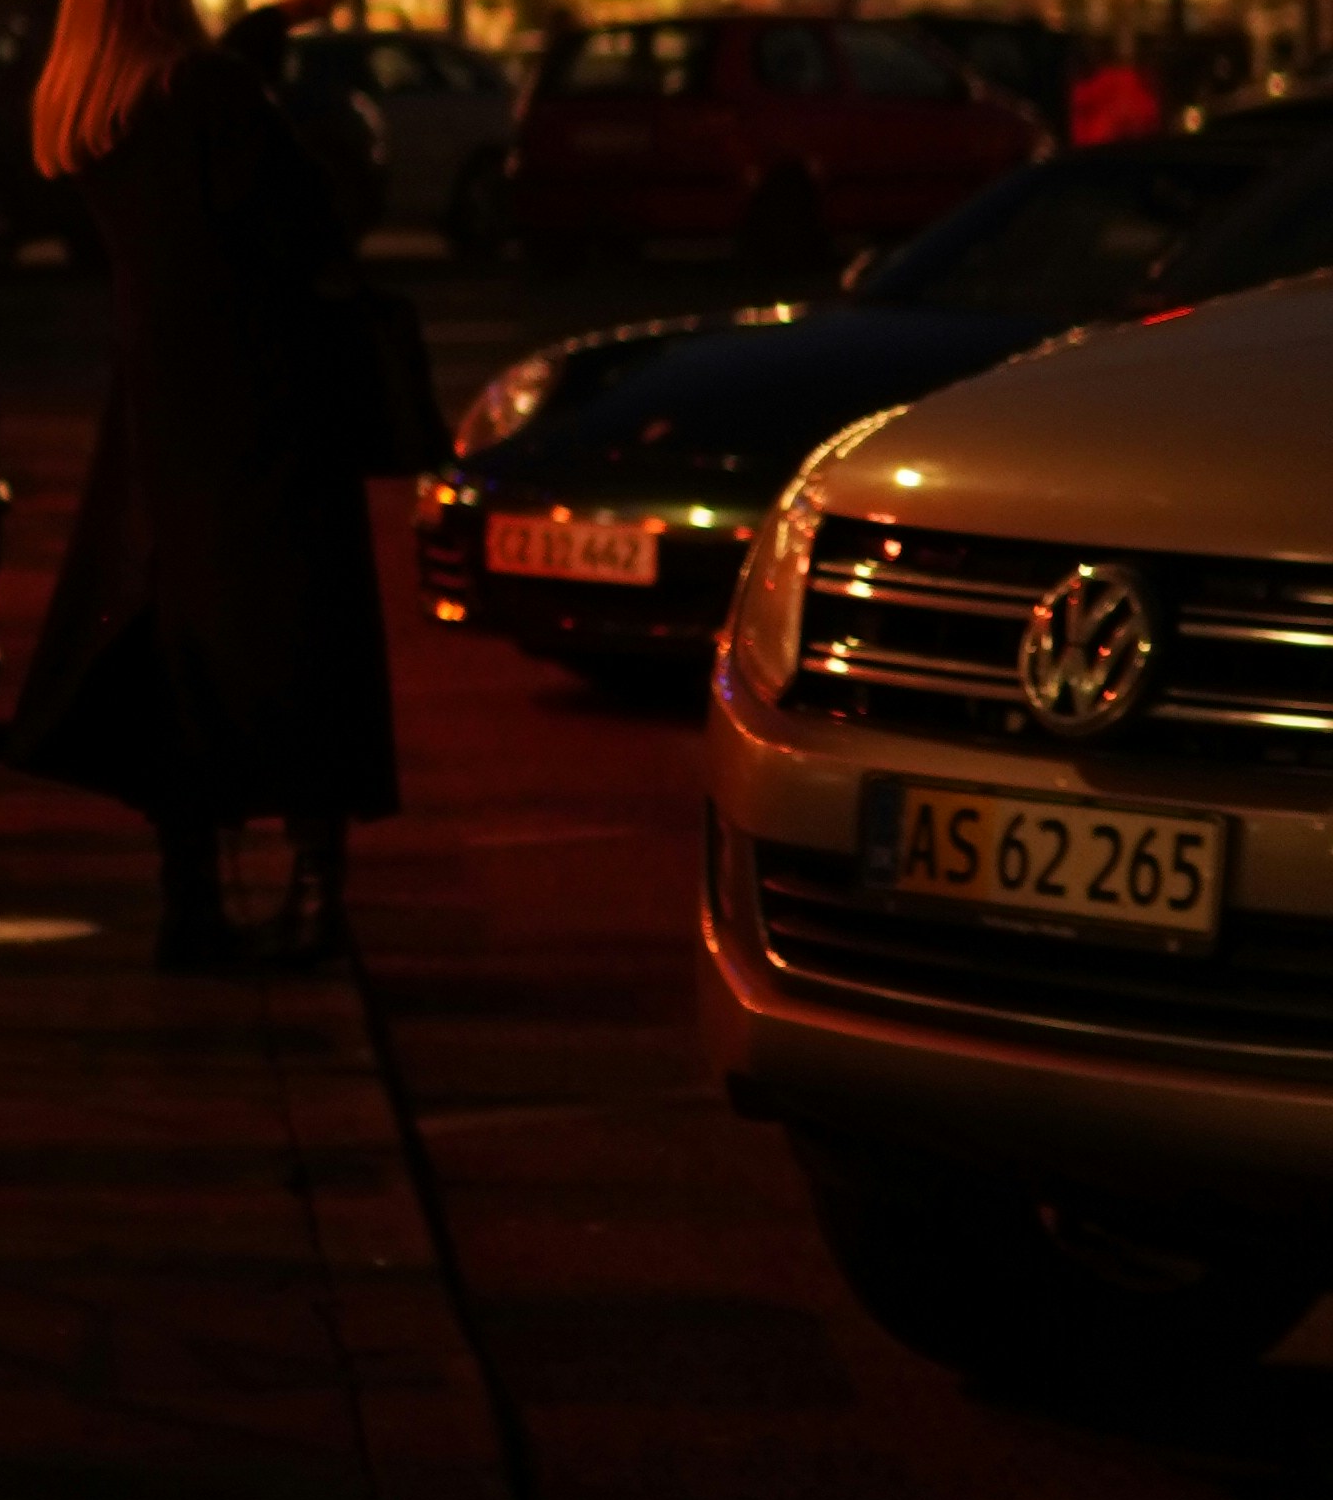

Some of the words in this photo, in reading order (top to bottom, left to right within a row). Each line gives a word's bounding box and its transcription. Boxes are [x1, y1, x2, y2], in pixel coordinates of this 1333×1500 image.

[906, 801, 981, 885] AS
[996, 811, 1070, 897] 62
[1086, 824, 1205, 912] 265
